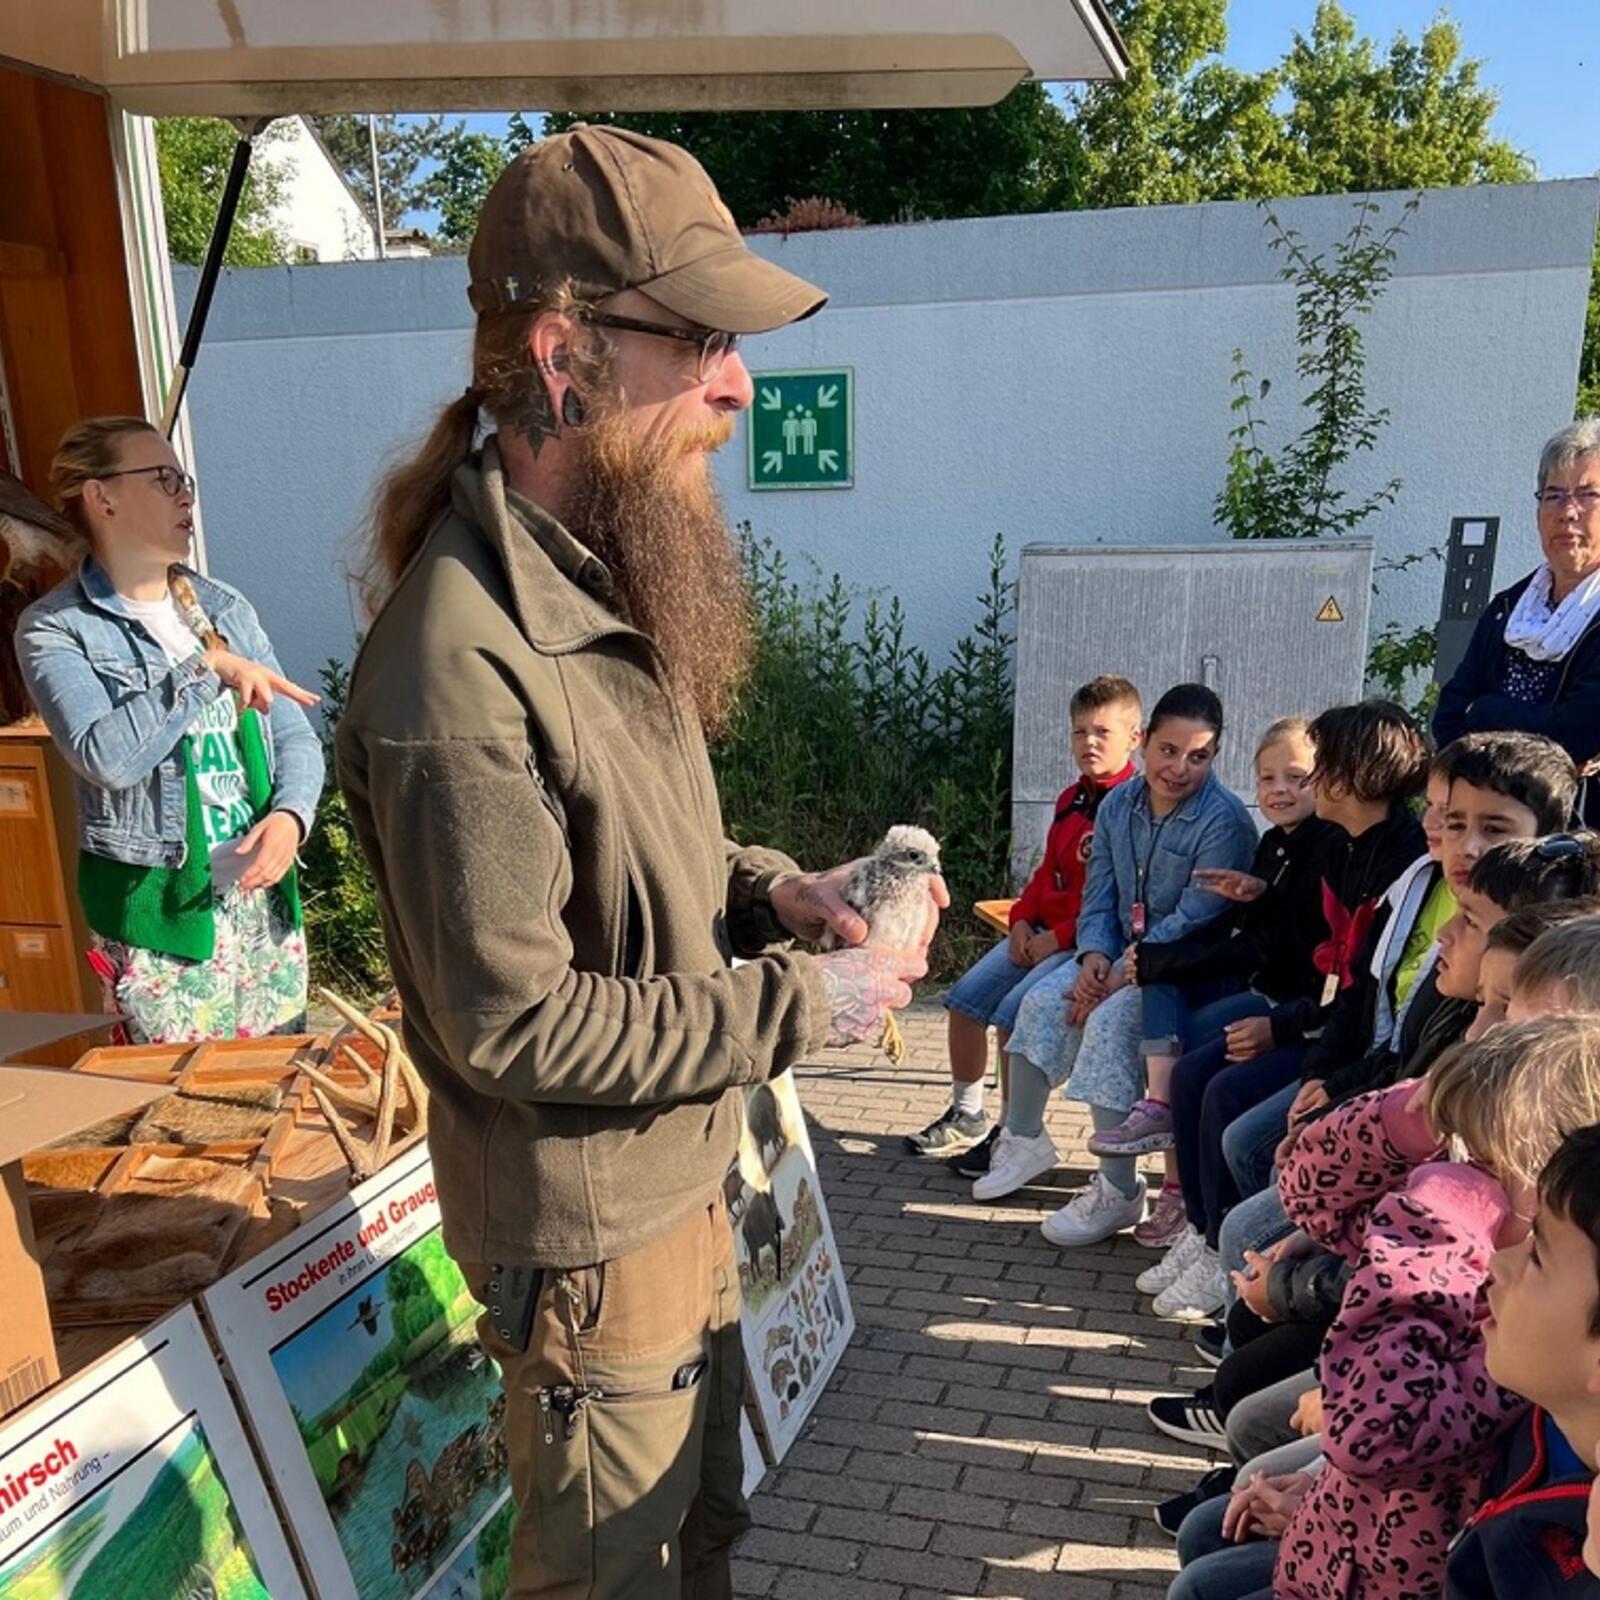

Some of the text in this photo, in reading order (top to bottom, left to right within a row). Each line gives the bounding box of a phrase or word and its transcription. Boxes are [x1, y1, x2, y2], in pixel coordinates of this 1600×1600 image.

[193, 731, 239, 774] AL
[265, 1239, 357, 1312] Stockente
[357, 1210, 388, 1249] und
[388, 1182, 437, 1224] Graug
[0, 1516, 23, 1541] um
[23, 1492, 50, 1521] und
[48, 1457, 103, 1501] Nahrung
